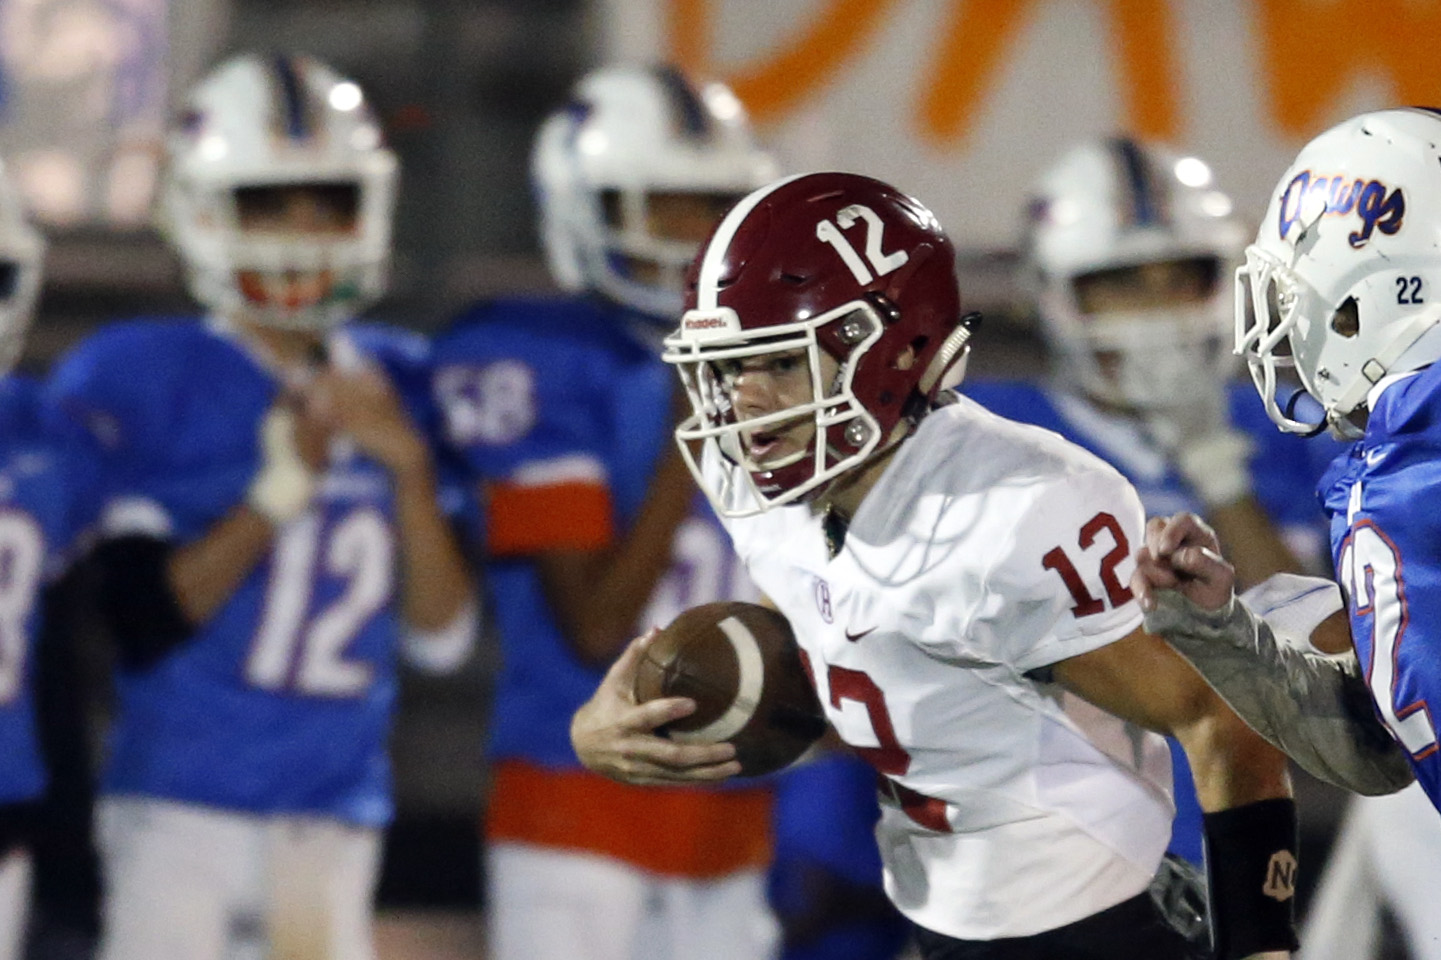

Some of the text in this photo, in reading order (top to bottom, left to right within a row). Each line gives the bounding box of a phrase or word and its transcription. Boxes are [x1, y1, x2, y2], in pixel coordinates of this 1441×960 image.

[816, 204, 909, 286] 12
[1278, 169, 1405, 249] Dawgs
[1396, 276, 1424, 304] 22
[243, 510, 391, 694] 12
[1042, 511, 1131, 619] 12
